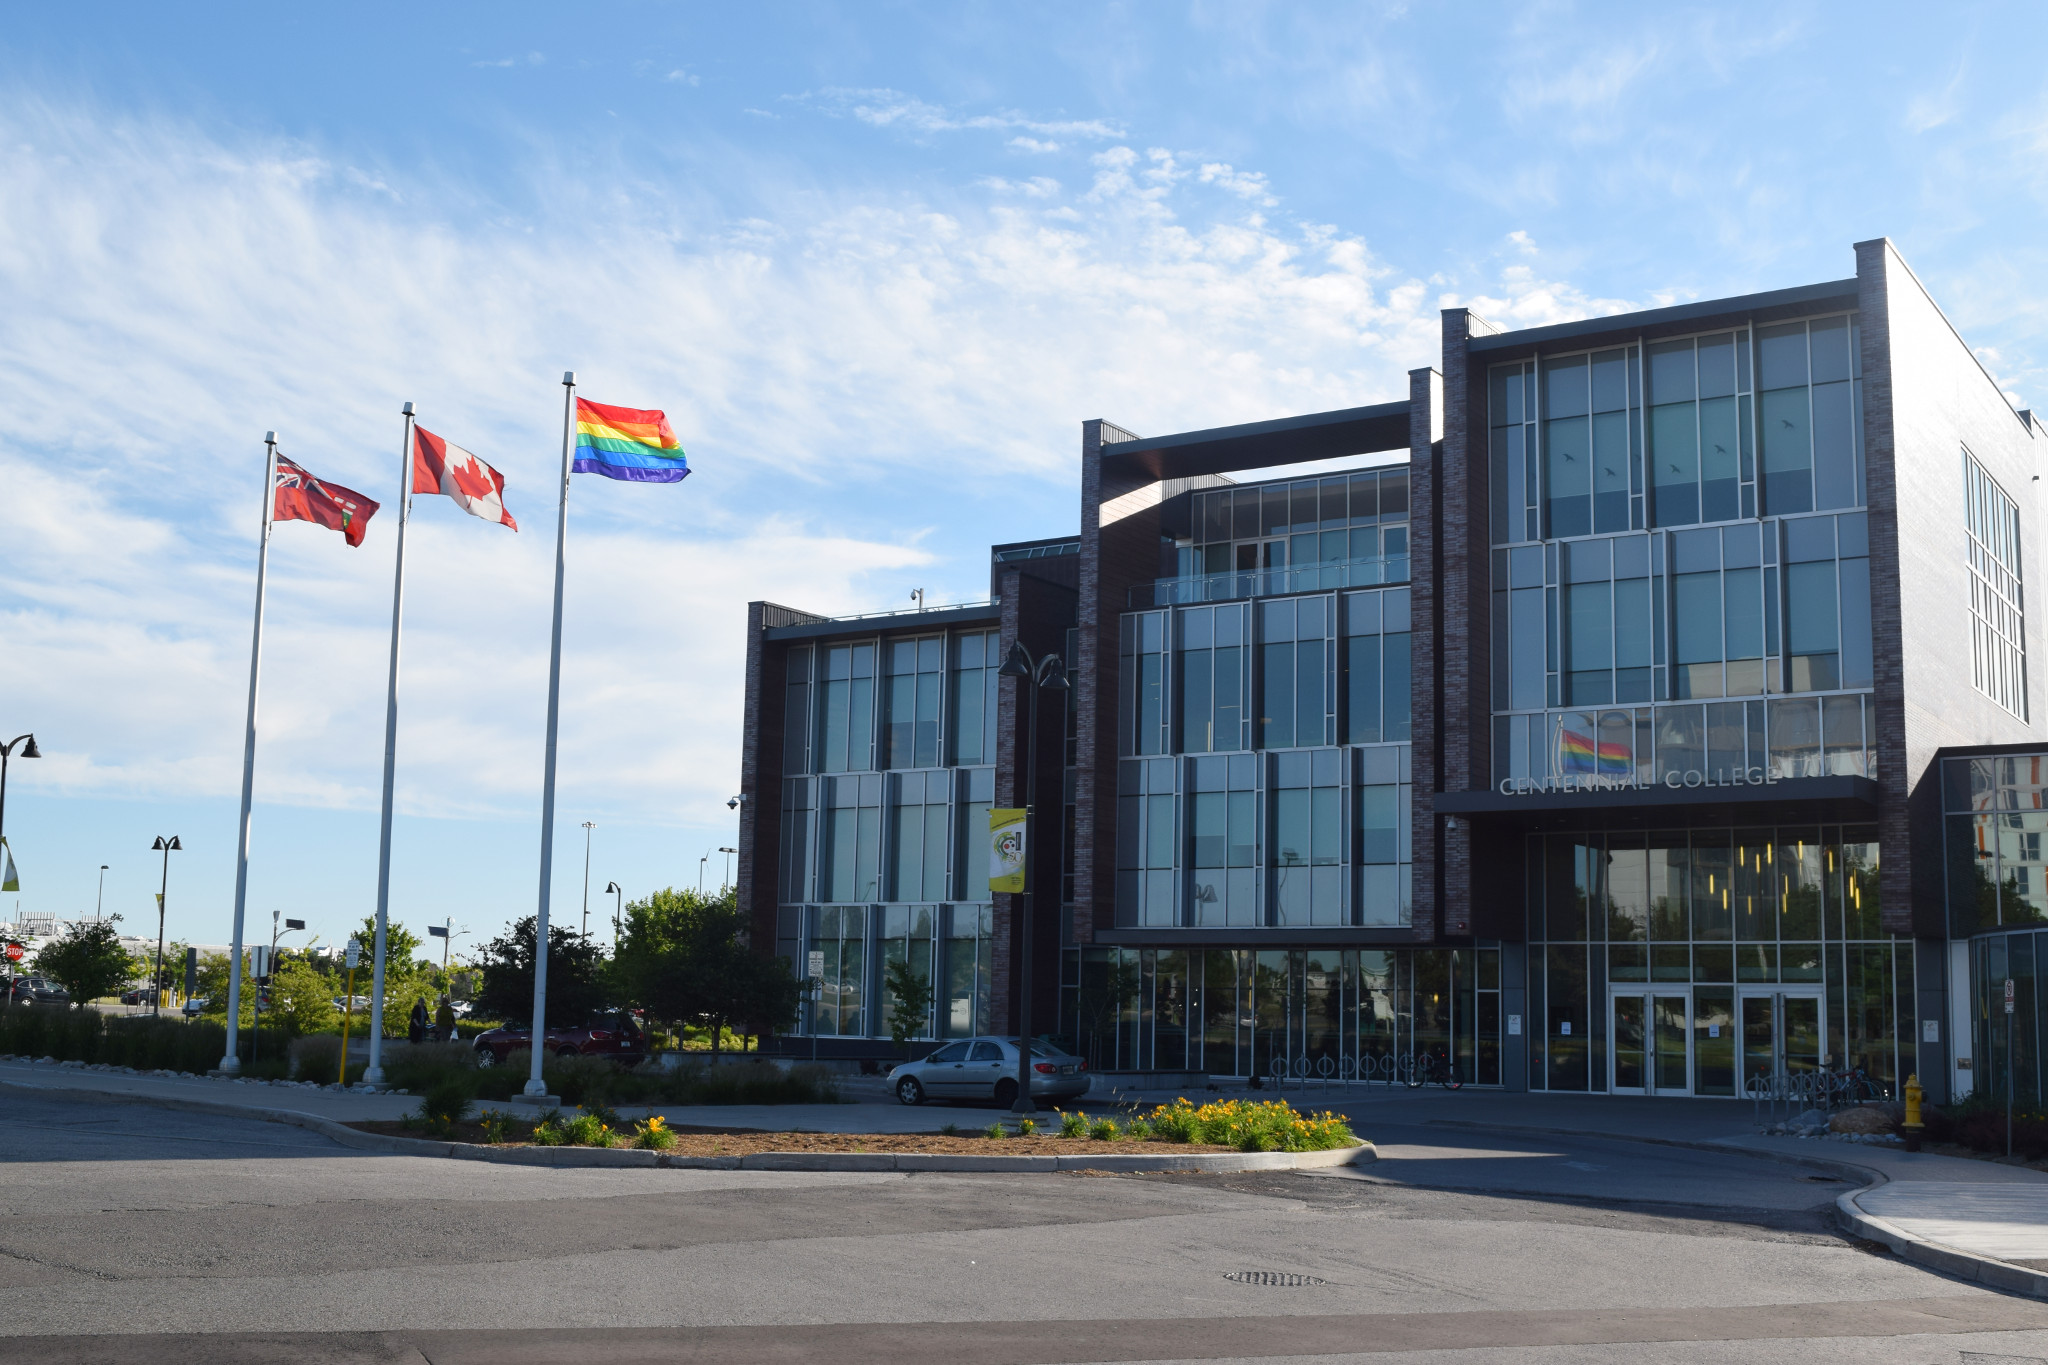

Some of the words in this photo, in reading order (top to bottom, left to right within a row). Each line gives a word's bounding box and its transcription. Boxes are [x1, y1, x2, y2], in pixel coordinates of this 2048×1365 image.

[1499, 774, 1650, 796] CENTENNIAL
[1666, 766, 1778, 789] COLLEGE
[8, 947, 24, 956] STOP
